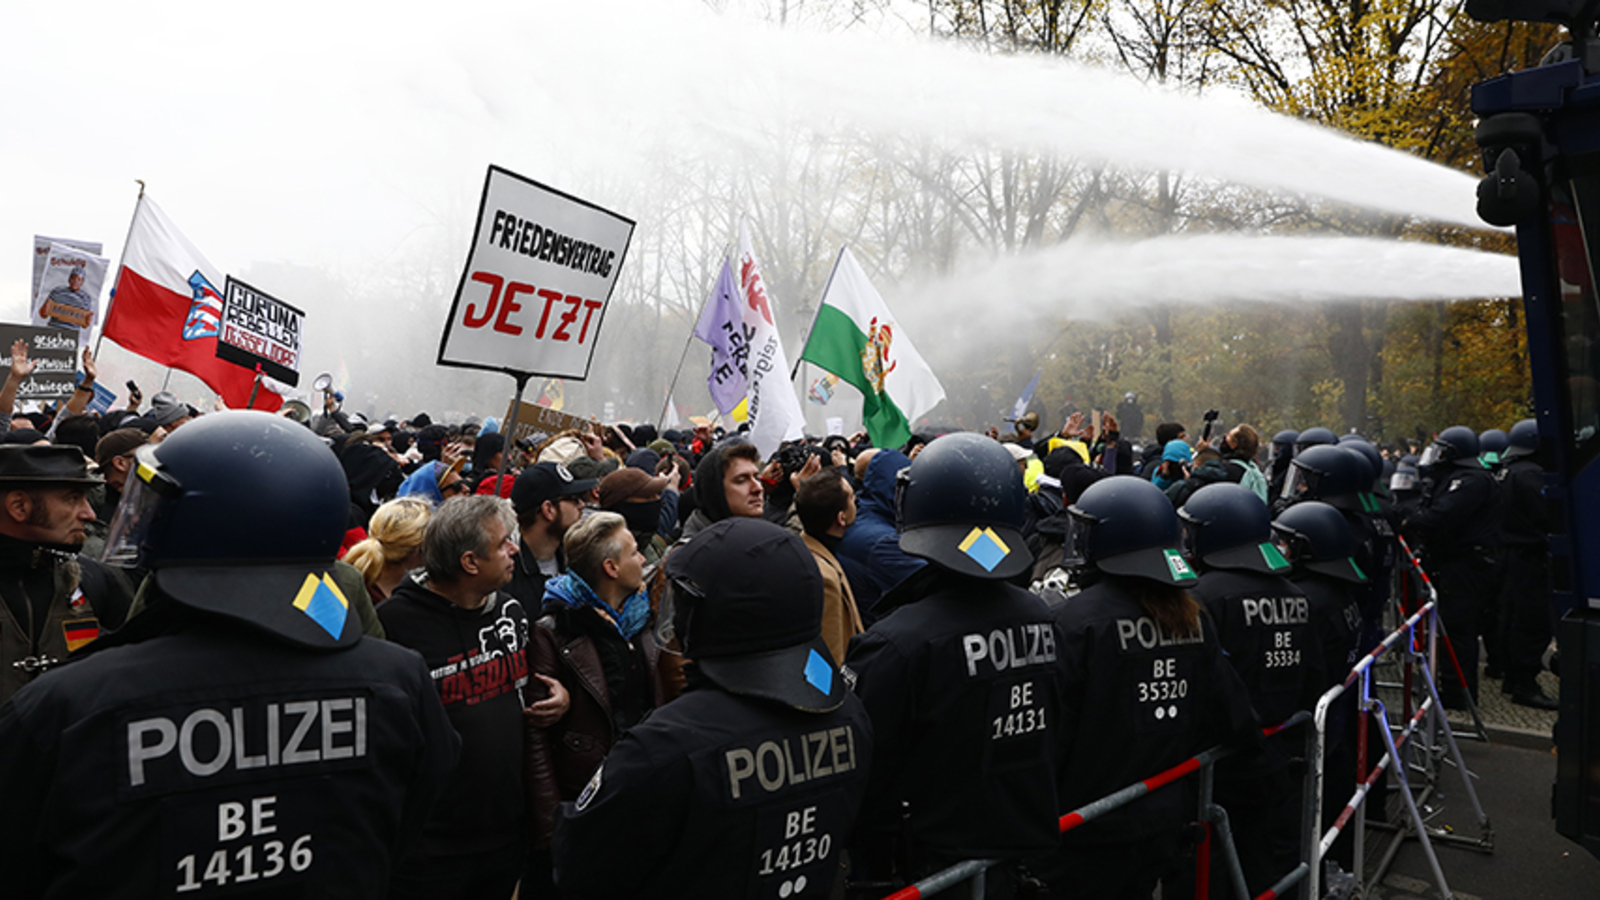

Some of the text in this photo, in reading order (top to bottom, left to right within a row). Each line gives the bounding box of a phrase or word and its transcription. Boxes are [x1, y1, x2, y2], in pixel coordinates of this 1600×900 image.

[226, 305, 298, 350] REBELLEN
[229, 284, 299, 333] CORONA
[462, 271, 603, 345] JETZT
[1265, 649, 1301, 668] 35334
[1274, 631, 1292, 648] BE
[1153, 658, 1176, 678] BE
[1010, 682, 1033, 709] BE
[1137, 679, 1188, 703] 35320
[128, 697, 366, 786] POLIZEI
[992, 707, 1046, 740] 14131
[725, 725, 856, 799] POLIZEI
[218, 796, 277, 842] BE
[785, 806, 817, 840] BE
[176, 834, 314, 893] 14136
[759, 833, 831, 875] 14130
